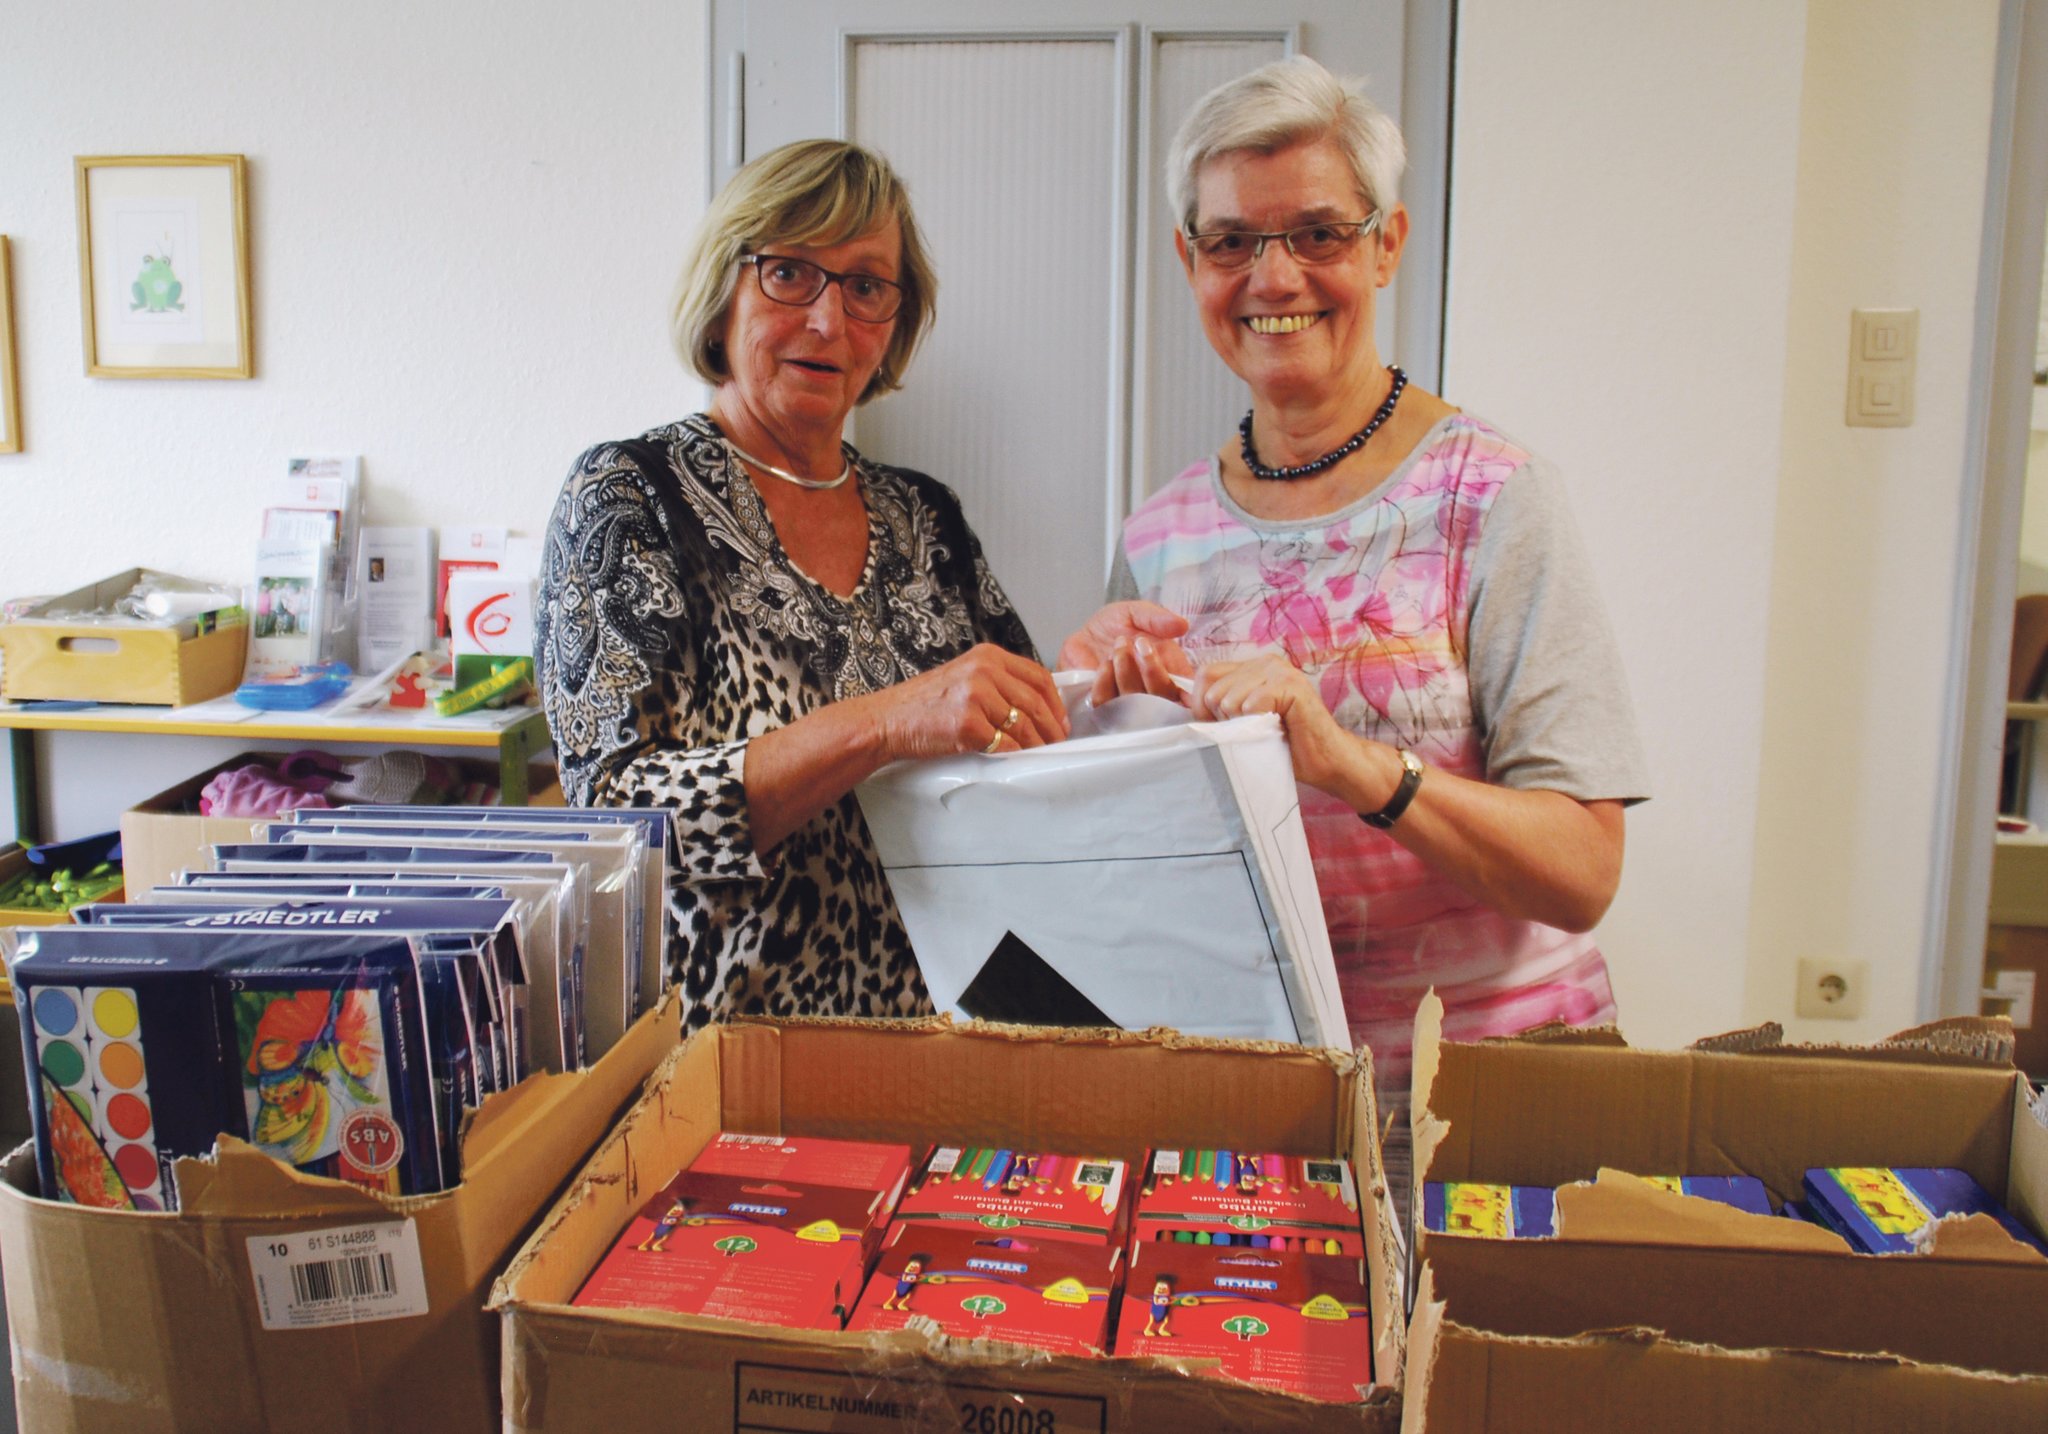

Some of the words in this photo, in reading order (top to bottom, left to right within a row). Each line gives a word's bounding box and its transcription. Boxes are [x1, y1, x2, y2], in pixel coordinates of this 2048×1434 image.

[210, 909, 381, 926] STAEDTLER
[731, 1203, 782, 1215] STYLEX
[976, 1202, 1034, 1214] Jumbo
[1218, 1202, 1278, 1214] Jumbo
[267, 1243, 289, 1257] 10
[308, 1238, 323, 1250] 61
[326, 1230, 377, 1248] S144888
[725, 1238, 749, 1251] 12
[969, 1259, 1022, 1273] STYLEX
[1216, 1277, 1271, 1289] STYLEX
[973, 1299, 997, 1312] 12
[1234, 1320, 1259, 1333] 12
[962, 1402, 1055, 1434] 26008
